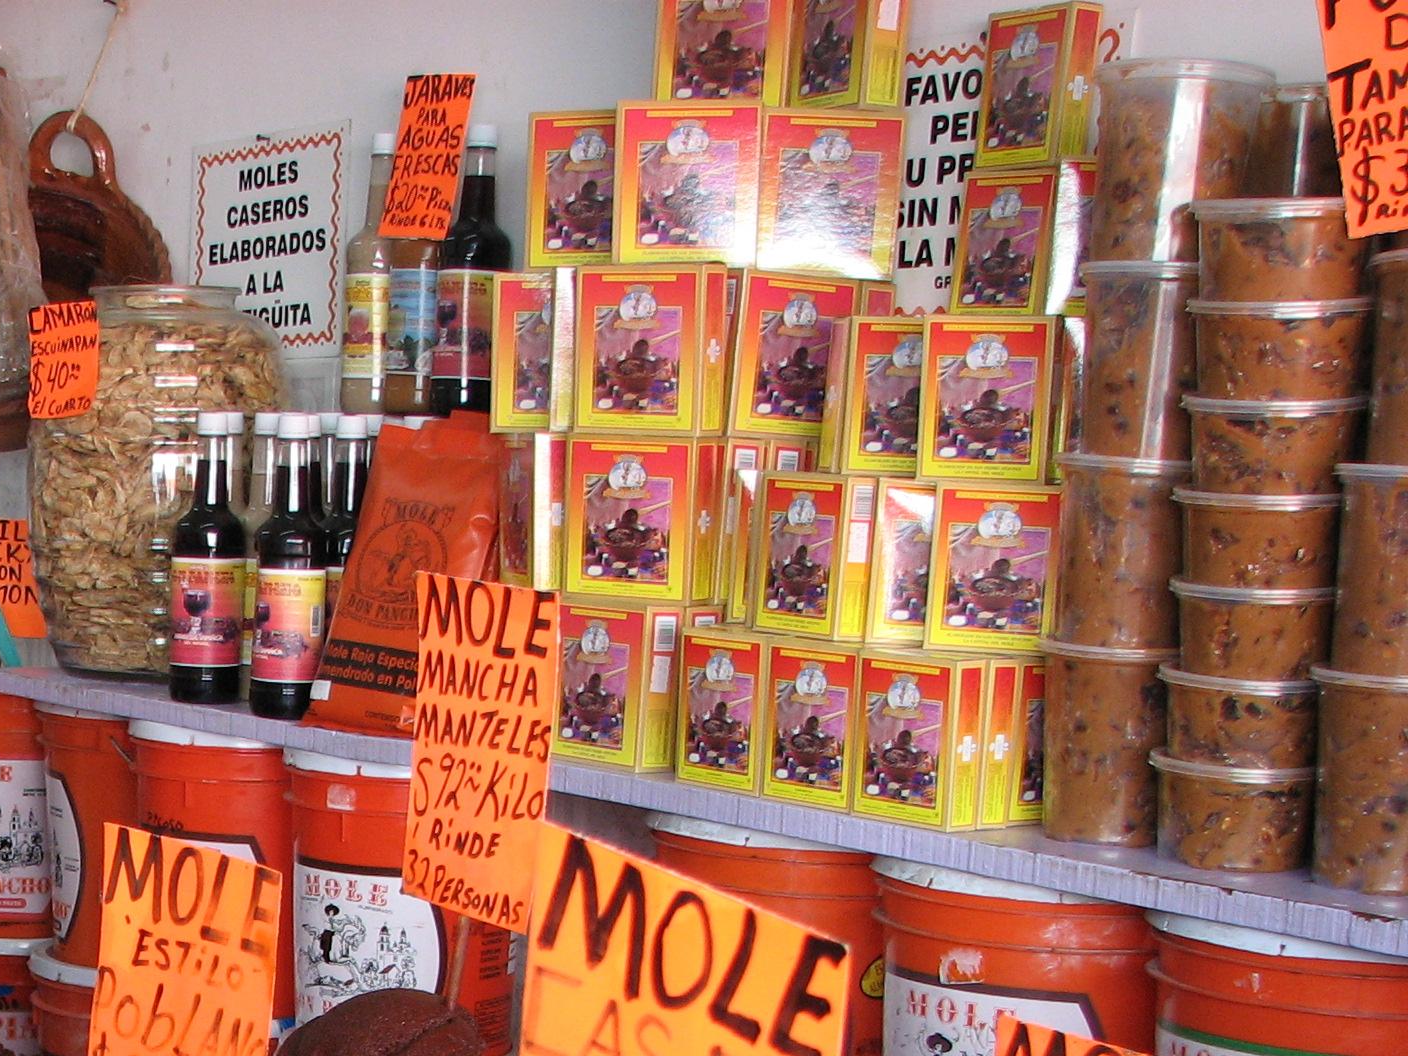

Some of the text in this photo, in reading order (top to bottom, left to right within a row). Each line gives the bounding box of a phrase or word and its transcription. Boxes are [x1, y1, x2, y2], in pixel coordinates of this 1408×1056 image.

[904, 68, 983, 107] FAVO
[416, 107, 447, 126] PARA
[398, 124, 463, 151] AGUAS
[238, 160, 299, 192] MOLES
[391, 153, 461, 180] FRESCAS
[905, 158, 926, 188] U
[227, 194, 309, 229] CASEROS
[209, 228, 327, 266] ELABORADOS
[245, 270, 284, 296] A LA
[418, 575, 555, 659] MOLE
[351, 647, 375, 666] Rojo
[377, 674, 417, 691] en Pol
[418, 649, 538, 708] MANCHA
[414, 703, 552, 764] MANTELES
[105, 827, 281, 953] MOLE
[304, 873, 389, 907] MOLE
[405, 848, 525, 926] 32 PERSONAS
